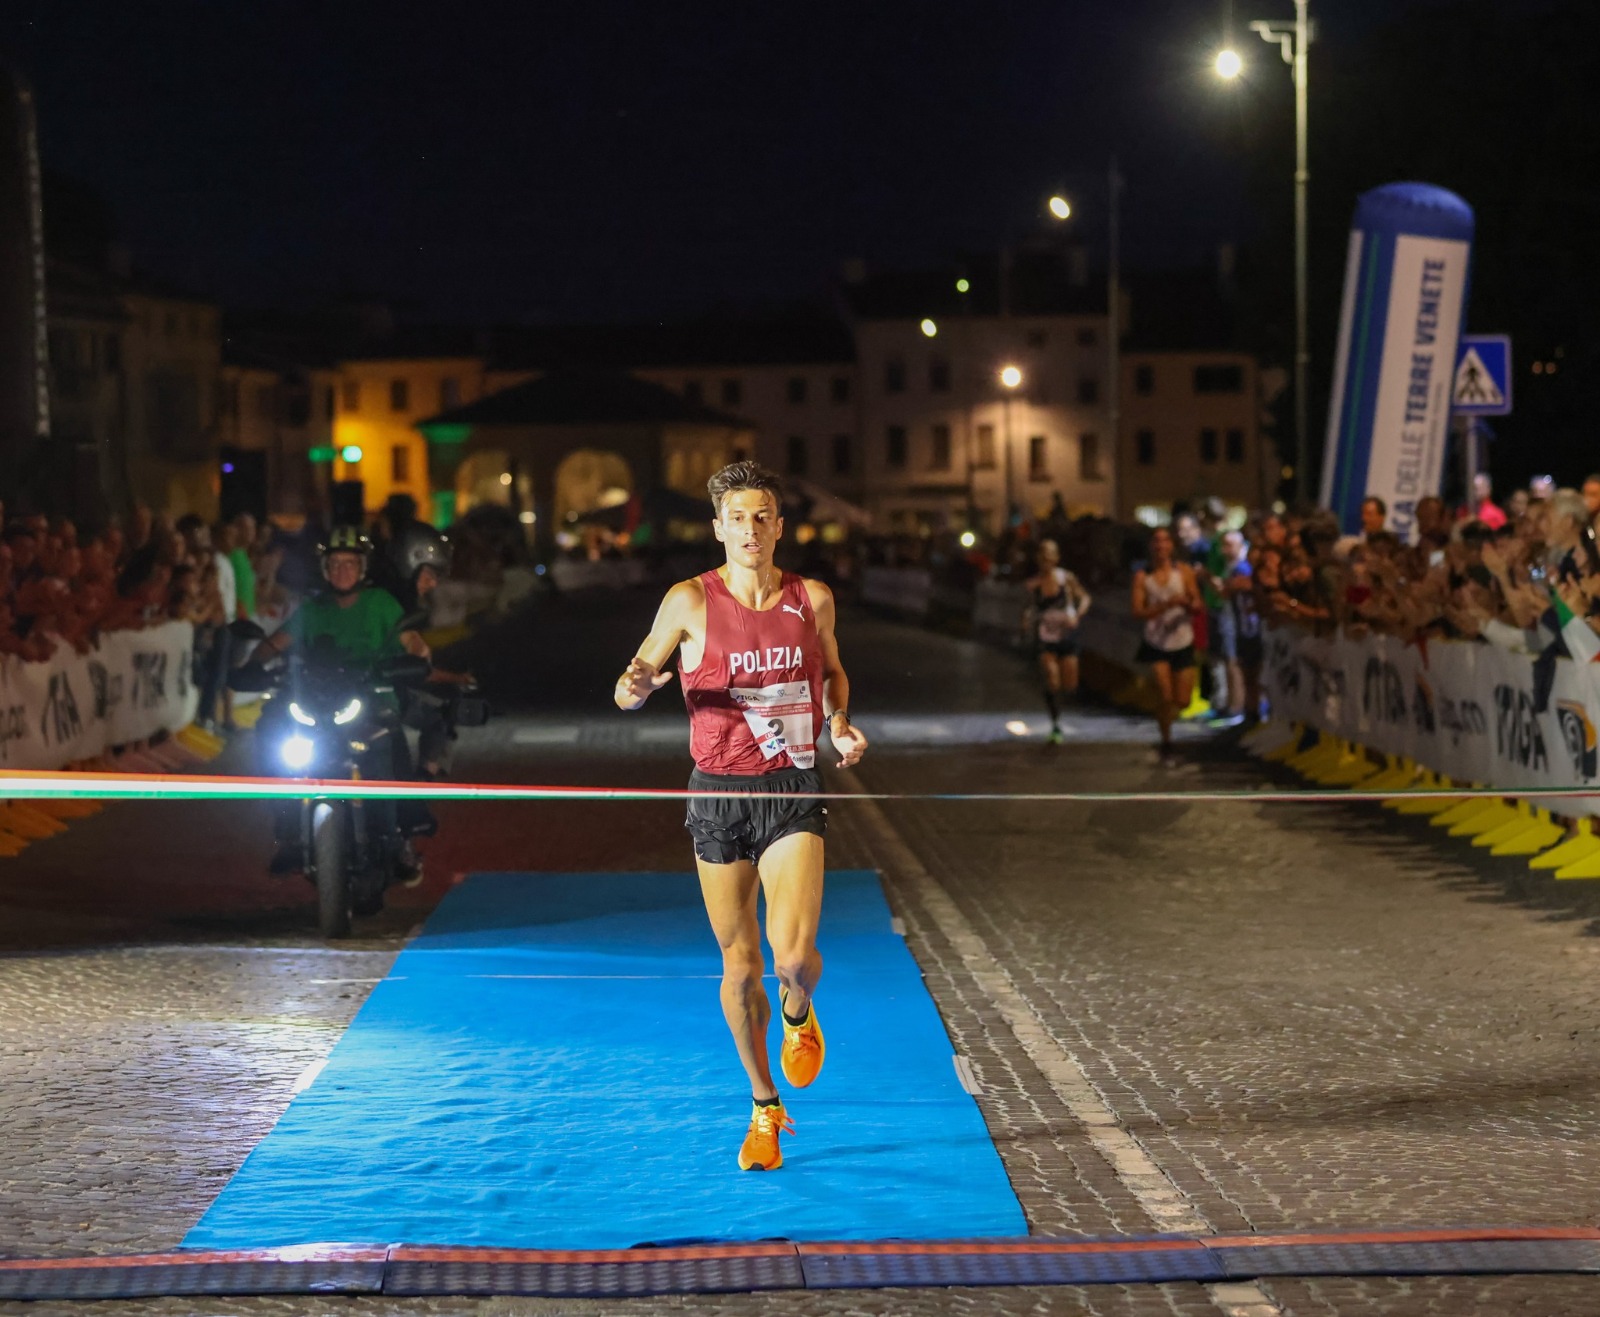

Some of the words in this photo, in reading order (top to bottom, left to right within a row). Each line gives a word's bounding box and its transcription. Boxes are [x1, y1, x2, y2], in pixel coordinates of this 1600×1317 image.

[1415, 257, 1446, 345] VENETE
[1405, 352, 1433, 425] TERRE
[1394, 430, 1424, 495] DELLE
[730, 646, 803, 675] POLIZIA
